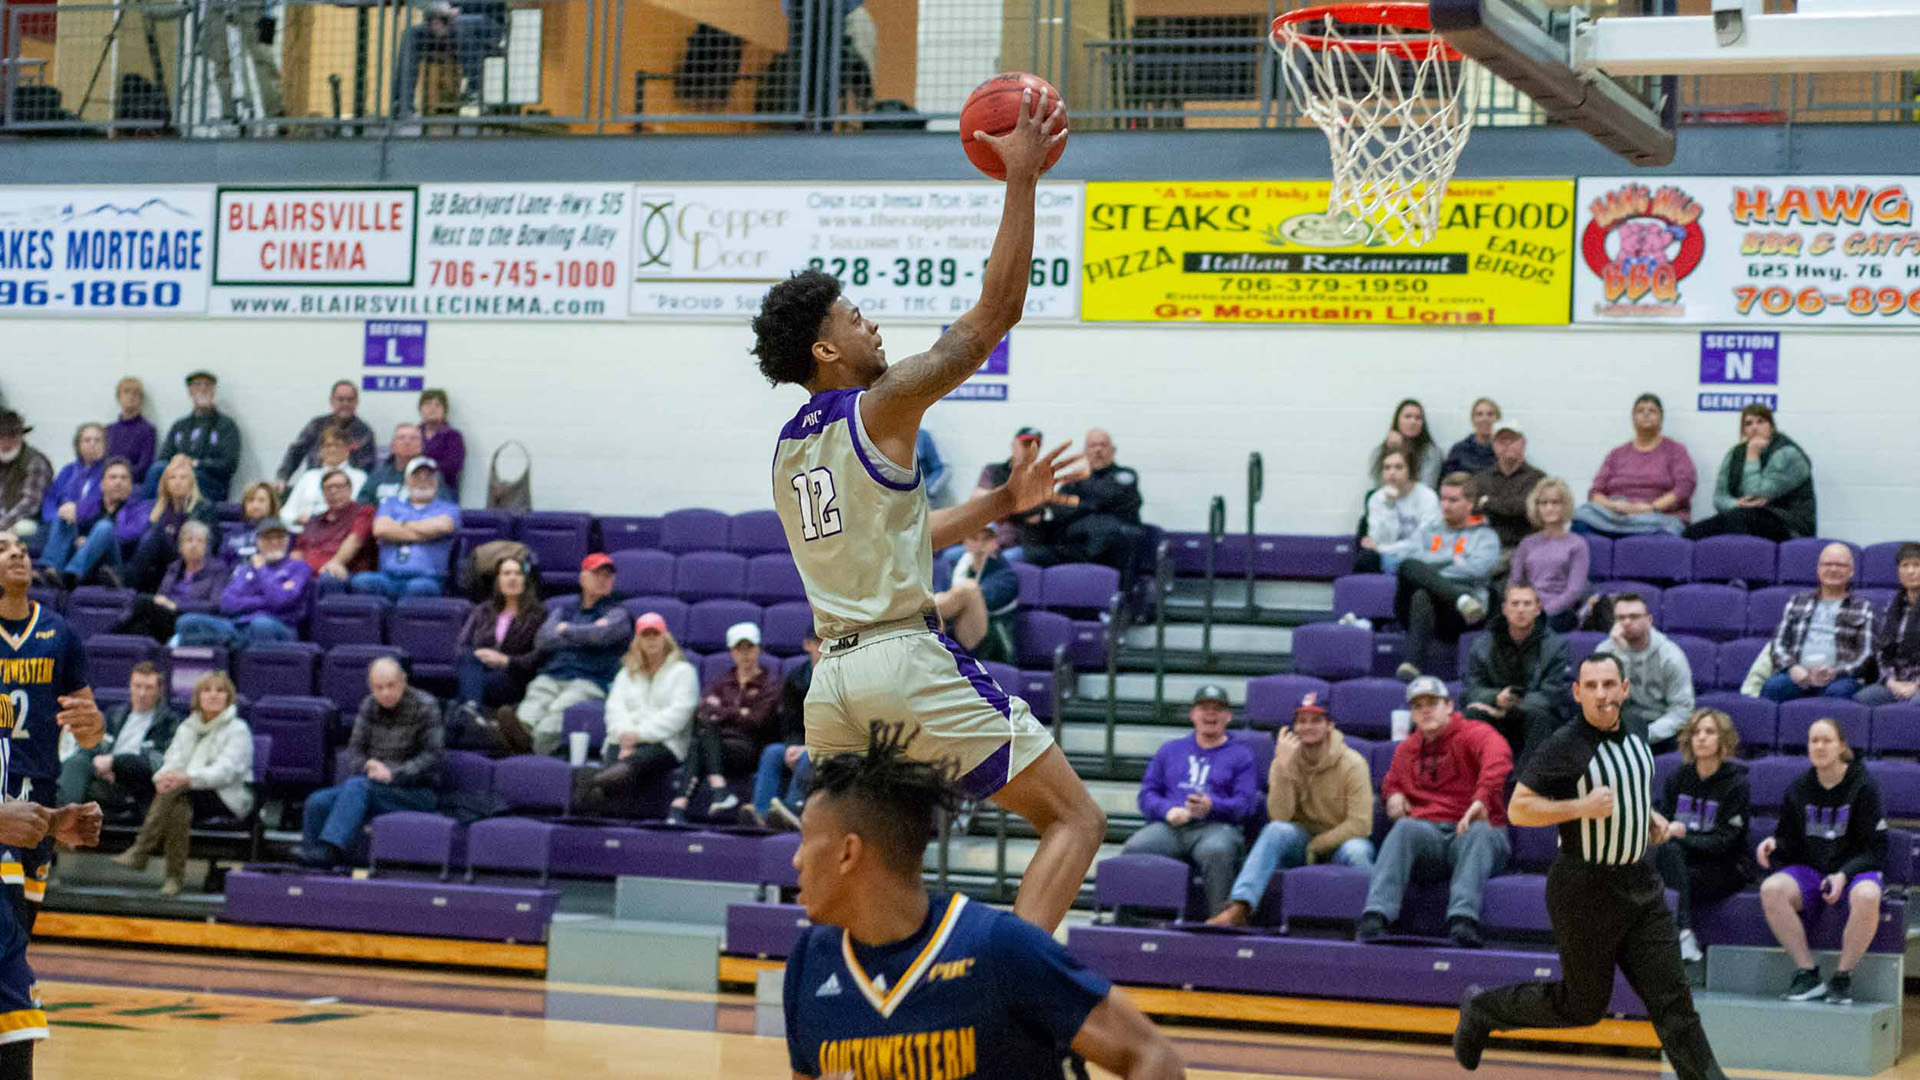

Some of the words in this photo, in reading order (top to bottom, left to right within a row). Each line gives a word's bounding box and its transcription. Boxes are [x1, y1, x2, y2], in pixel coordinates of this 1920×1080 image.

[228, 201, 404, 232] BLAIRSVILLE
[447, 192, 515, 219] Backyard
[598, 192, 624, 216] 515
[1090, 203, 1251, 232] STEAKS
[1399, 202, 1569, 230] AFOOD
[1732, 185, 1913, 227] HAWG
[430, 224, 465, 247] Next
[468, 225, 485, 247] to
[487, 224, 513, 247] the
[516, 223, 576, 251] Bowling
[578, 223, 619, 250] Alley
[677, 201, 790, 245] Copper
[66, 229, 202, 271] MORTGAGE
[260, 241, 367, 271] CINEMA
[693, 231, 768, 272] Door
[1486, 235, 1567, 264] EARLY
[1740, 231, 1803, 257] BBQ
[429, 259, 616, 288] 706-745-1000
[808, 256, 1070, 287] 28-389-60
[1084, 246, 1176, 284] PIZZA
[1198, 253, 1290, 272] Italian
[1302, 254, 1450, 273] Restaurant
[1474, 253, 1555, 286] BIRDS
[1748, 263, 1789, 279] 625
[1795, 263, 1848, 281] Hwy.
[1857, 263, 1883, 279] 76
[1218, 278, 1429, 293] 706-379-1950
[231, 295, 606, 316] www.BLAIRSVILLECINEMA.com
[1154, 303, 1202, 319] Go
[1214, 304, 1373, 320] Mountain
[1386, 306, 1496, 324] Lions!
[386, 338, 404, 363] L
[1705, 334, 1775, 349] SECTION
[1725, 351, 1754, 380] N
[791, 465, 843, 542] 12
[819, 1026, 975, 1080] SOUTHWESTERN
